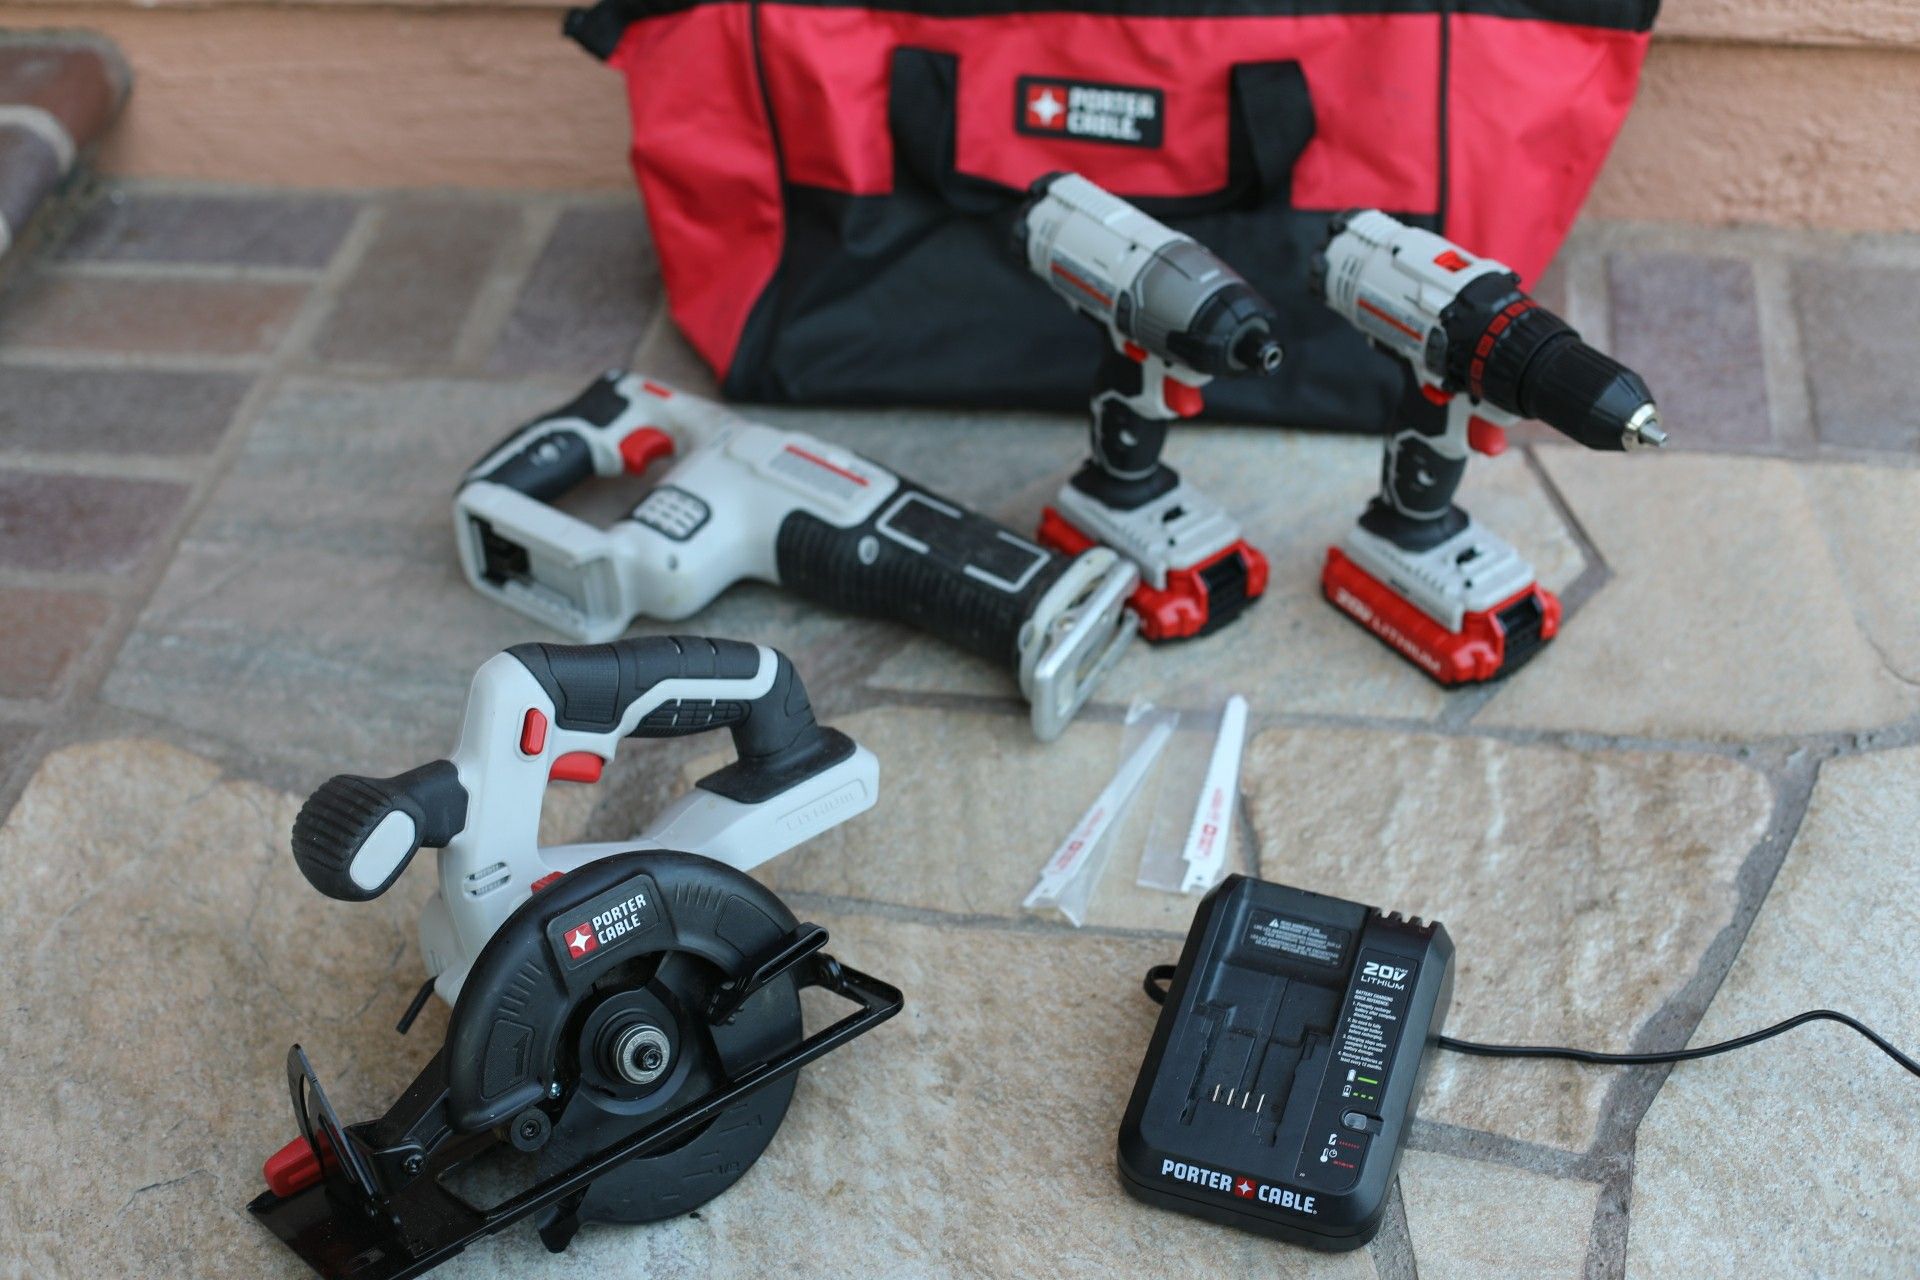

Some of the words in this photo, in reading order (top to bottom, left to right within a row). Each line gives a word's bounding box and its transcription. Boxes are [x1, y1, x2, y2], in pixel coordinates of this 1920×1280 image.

[592, 894, 647, 932] PORTER
[597, 914, 641, 945] CABLE
[1361, 976, 1405, 992] LITHIUM
[1363, 961, 1408, 982] 20V
[1161, 1159, 1233, 1192] PORTER
